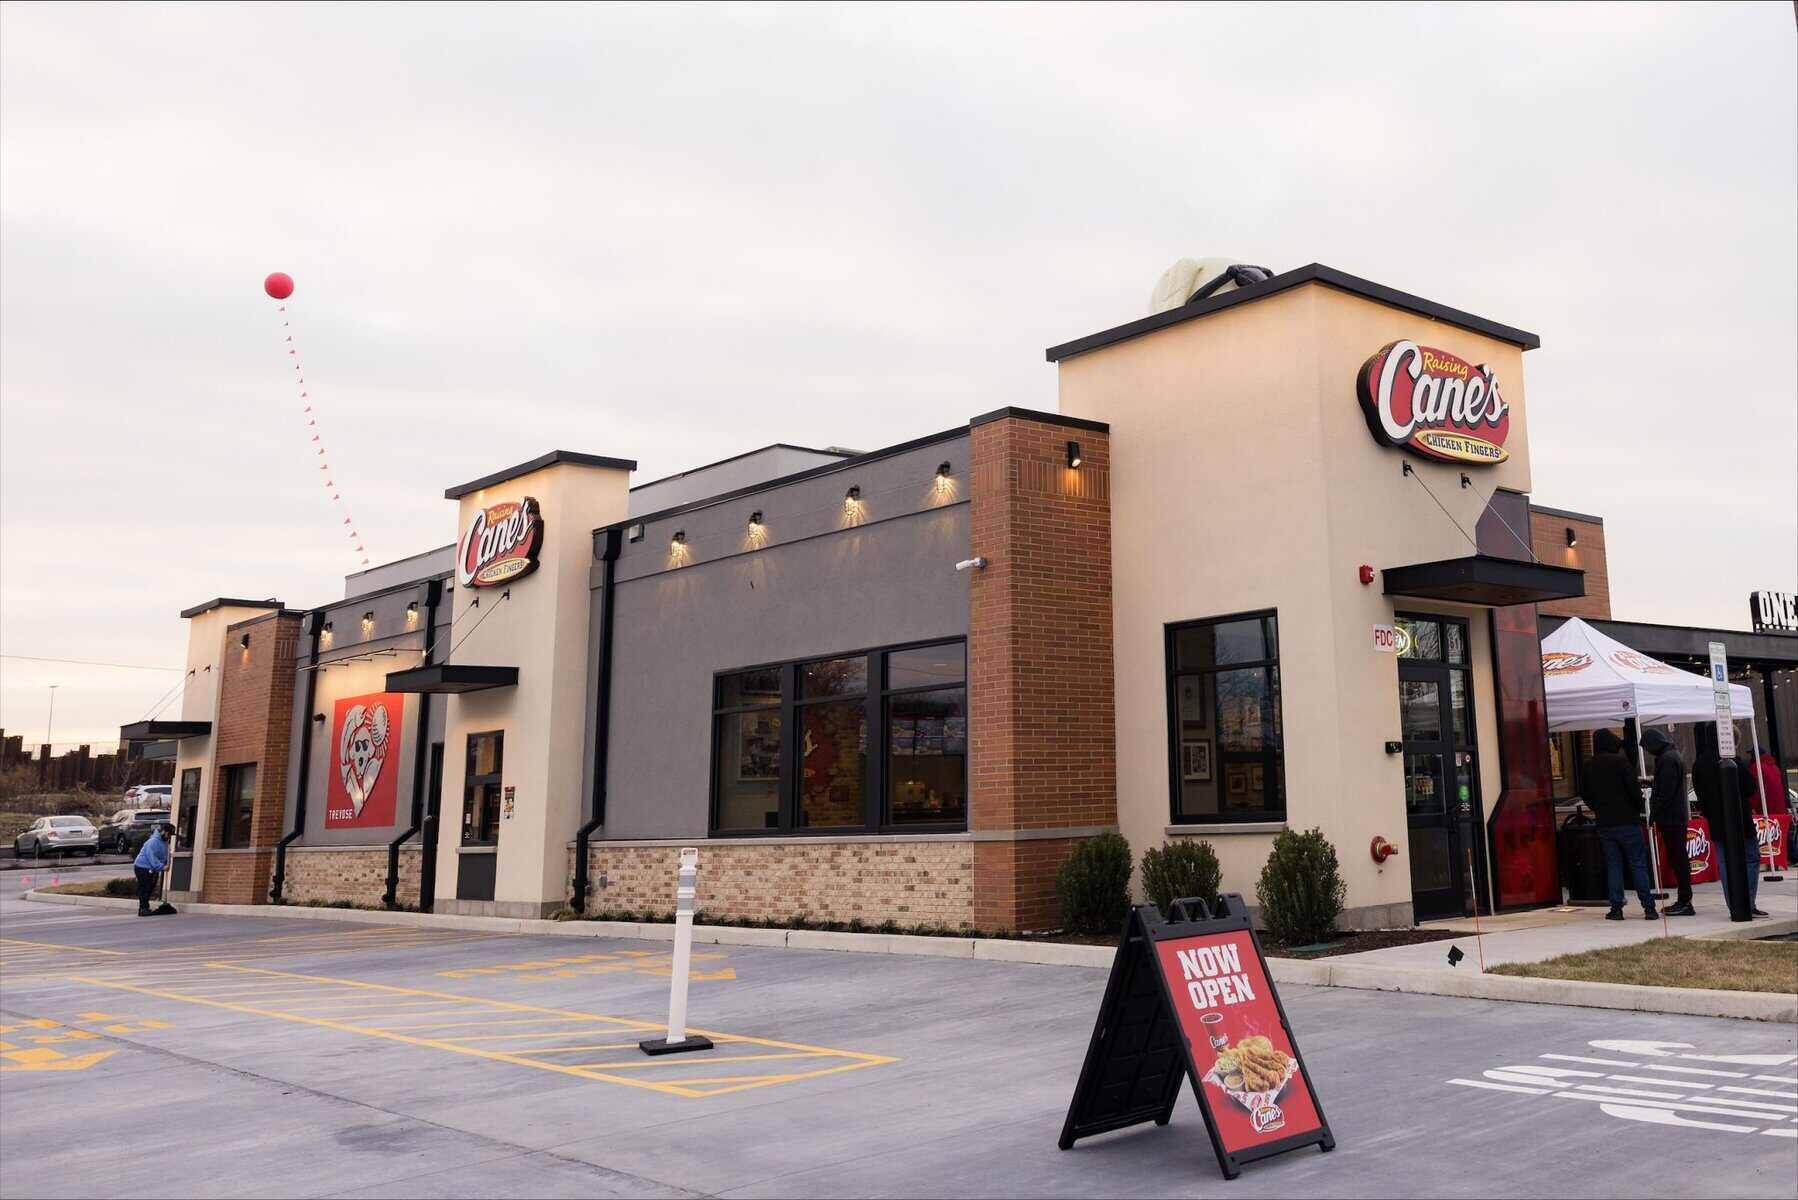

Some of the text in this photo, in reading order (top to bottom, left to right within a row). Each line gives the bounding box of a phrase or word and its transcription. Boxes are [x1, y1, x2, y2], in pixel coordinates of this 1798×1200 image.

[1423, 352, 1468, 380] Raising
[1378, 341, 1509, 439] Cane's
[1426, 433, 1501, 458] CHICKEN FINGERS
[1375, 629, 1393, 647] FDC
[1176, 943, 1242, 980] NOW
[1187, 973, 1256, 1010] OPEN
